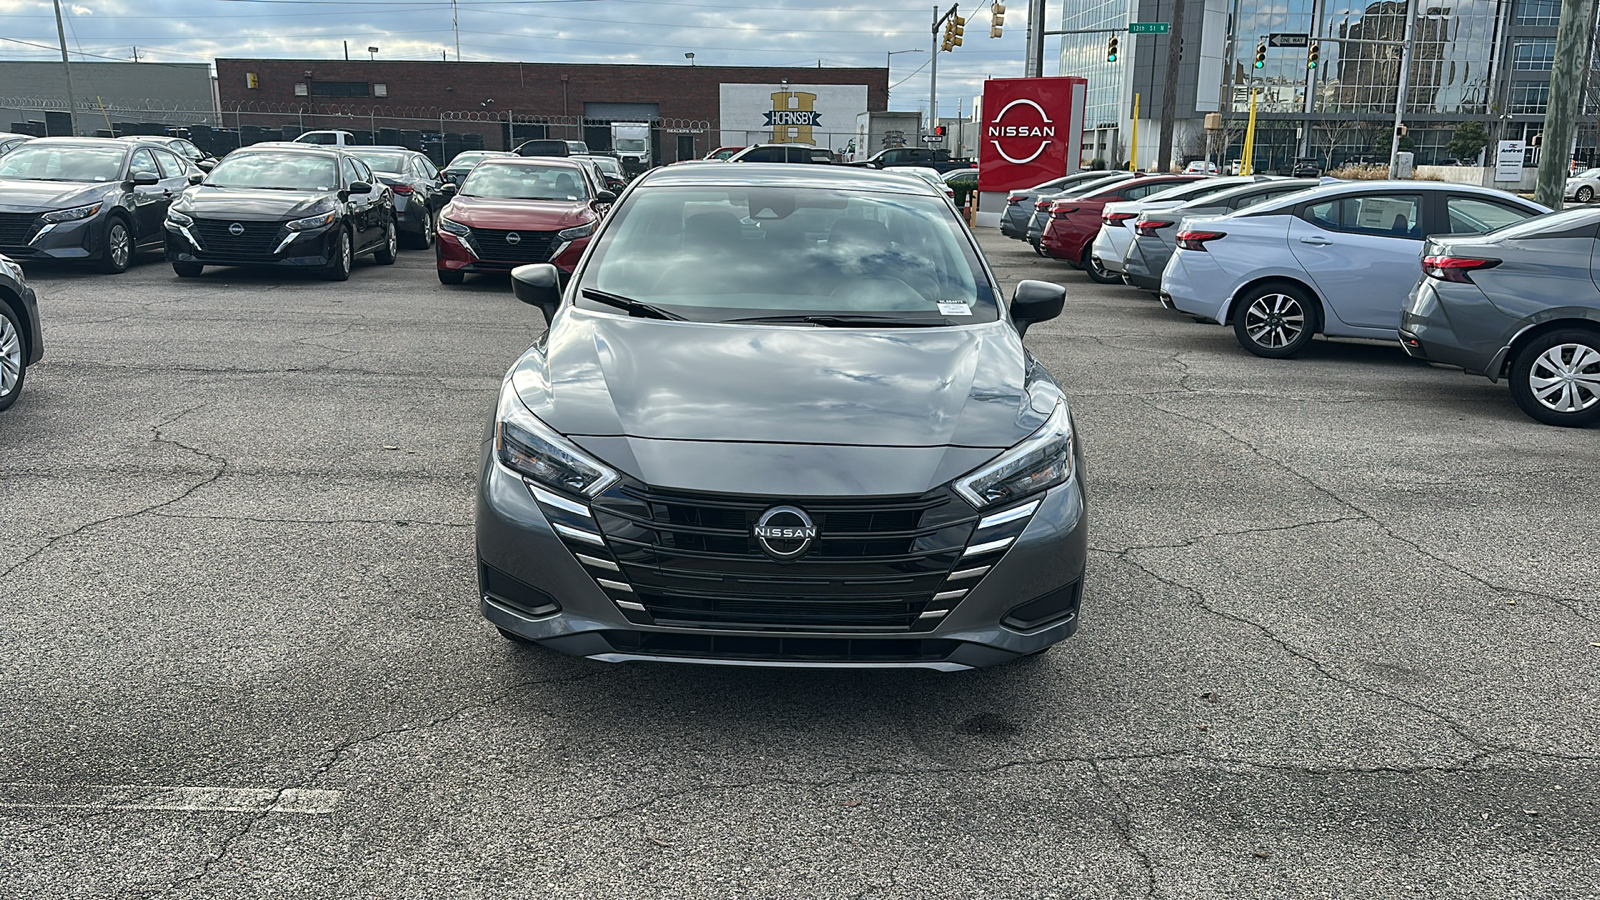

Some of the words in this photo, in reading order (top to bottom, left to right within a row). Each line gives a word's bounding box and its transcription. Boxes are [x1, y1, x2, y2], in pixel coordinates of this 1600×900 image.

[771, 111, 815, 125] HORNSBY
[988, 126, 1055, 137] NISSAN
[754, 527, 816, 538] NISSAN
